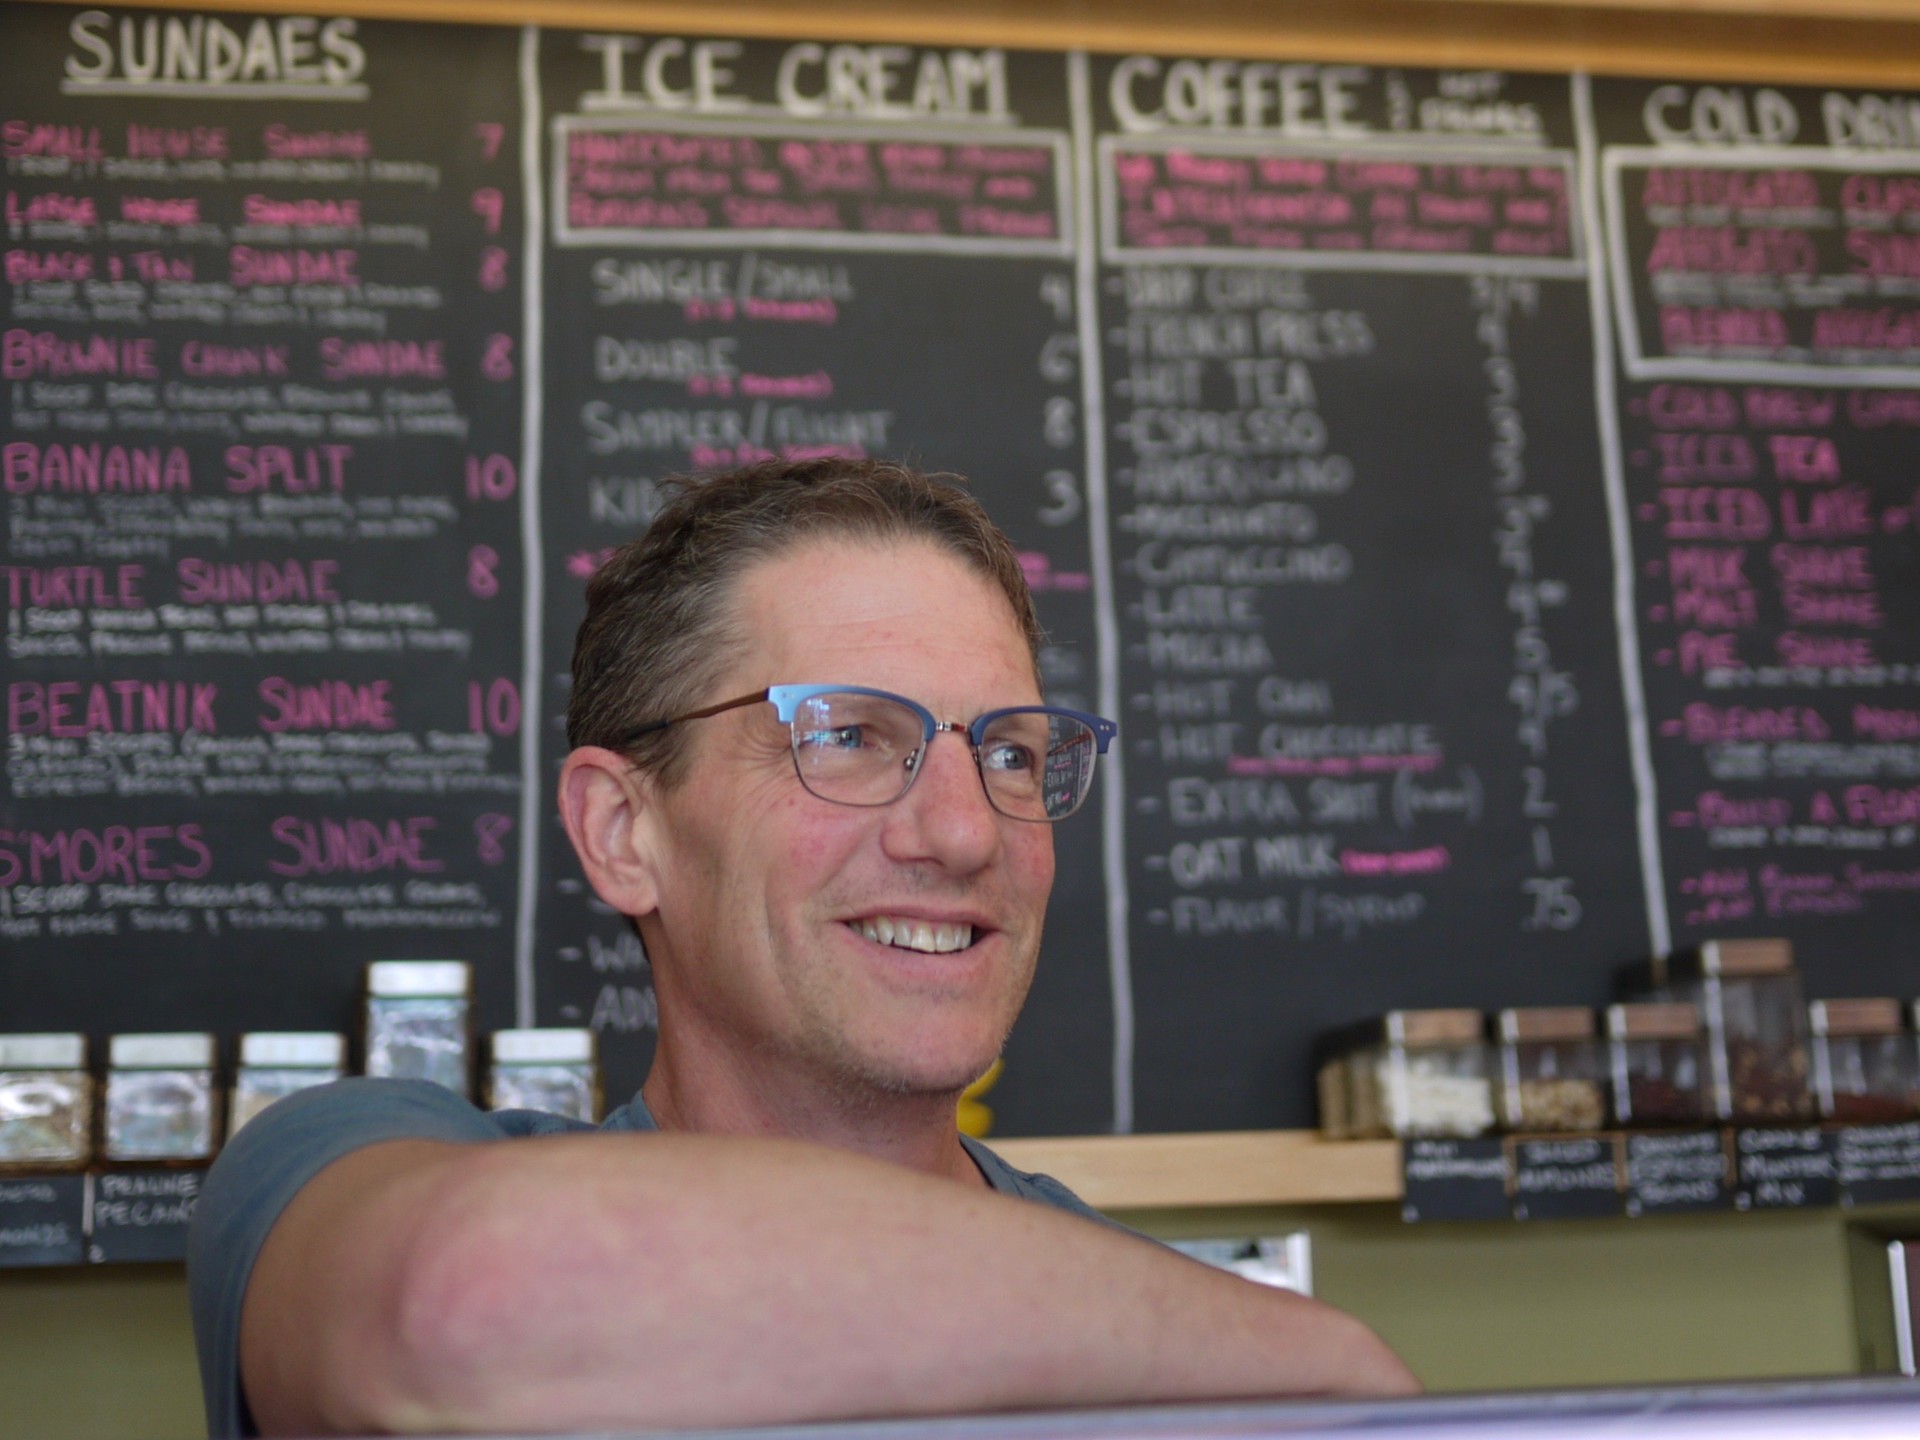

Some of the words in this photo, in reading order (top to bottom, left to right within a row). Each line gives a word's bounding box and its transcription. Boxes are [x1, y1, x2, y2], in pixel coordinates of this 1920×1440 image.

[64, 10, 367, 83] SUNDAES
[580, 34, 748, 110] ICE
[775, 40, 1010, 119] CREAM
[1110, 55, 1371, 138] COFFEE
[1, 120, 103, 160] SMALL
[476, 122, 505, 161] 7
[1643, 84, 1800, 148] COLD
[5, 191, 97, 227] LARGE
[243, 193, 362, 228] SUNDAE
[471, 187, 505, 236] 9
[4, 249, 95, 284] BLACK
[230, 245, 360, 288] SUNDAE
[479, 246, 509, 292] 8
[2, 328, 160, 379] BROWNIE
[180, 341, 290, 378] CHUNK
[319, 336, 448, 381] SUNDAE
[481, 332, 515, 381] 8
[595, 335, 739, 384] DOUBLE
[1039, 333, 1077, 385] 6
[1126, 309, 1254, 358] FRENCH
[1257, 308, 1377, 360] PRESS
[1227, 358, 1319, 408] TEA
[1043, 396, 1077, 449] 8
[1132, 406, 1328, 456] ESPRESSO
[2, 440, 193, 495] BANANA
[223, 443, 354, 494] SPLIT
[465, 453, 518, 500] 10
[1134, 453, 1356, 498] AMERICANO
[1767, 433, 1842, 484] TEA
[1037, 469, 1080, 528] 3
[1657, 486, 1773, 541] ICED
[0, 563, 147, 609] TURTLE
[176, 557, 341, 602] SUNDAE
[467, 543, 501, 598] 8
[1134, 541, 1355, 585] CAPPUCCINO
[1145, 629, 1277, 673] MOCHA
[1514, 625, 1552, 674] 5
[7, 680, 220, 739] BEATNIK
[257, 676, 399, 735] SUNDAE
[467, 677, 522, 739] 10
[1153, 678, 1236, 717] HOT
[1159, 722, 1245, 763] HOT
[1258, 722, 1444, 760] CHOCOLATE
[1167, 775, 1300, 827] EXTRA
[1521, 766, 1559, 819] 2
[0, 822, 213, 887] S'MORES
[267, 815, 447, 880] SUNDAE
[474, 811, 514, 866] 8
[1168, 838, 1248, 889] OAT
[1251, 834, 1342, 879] MILK
[102, 1173, 200, 1199] PRALINE
